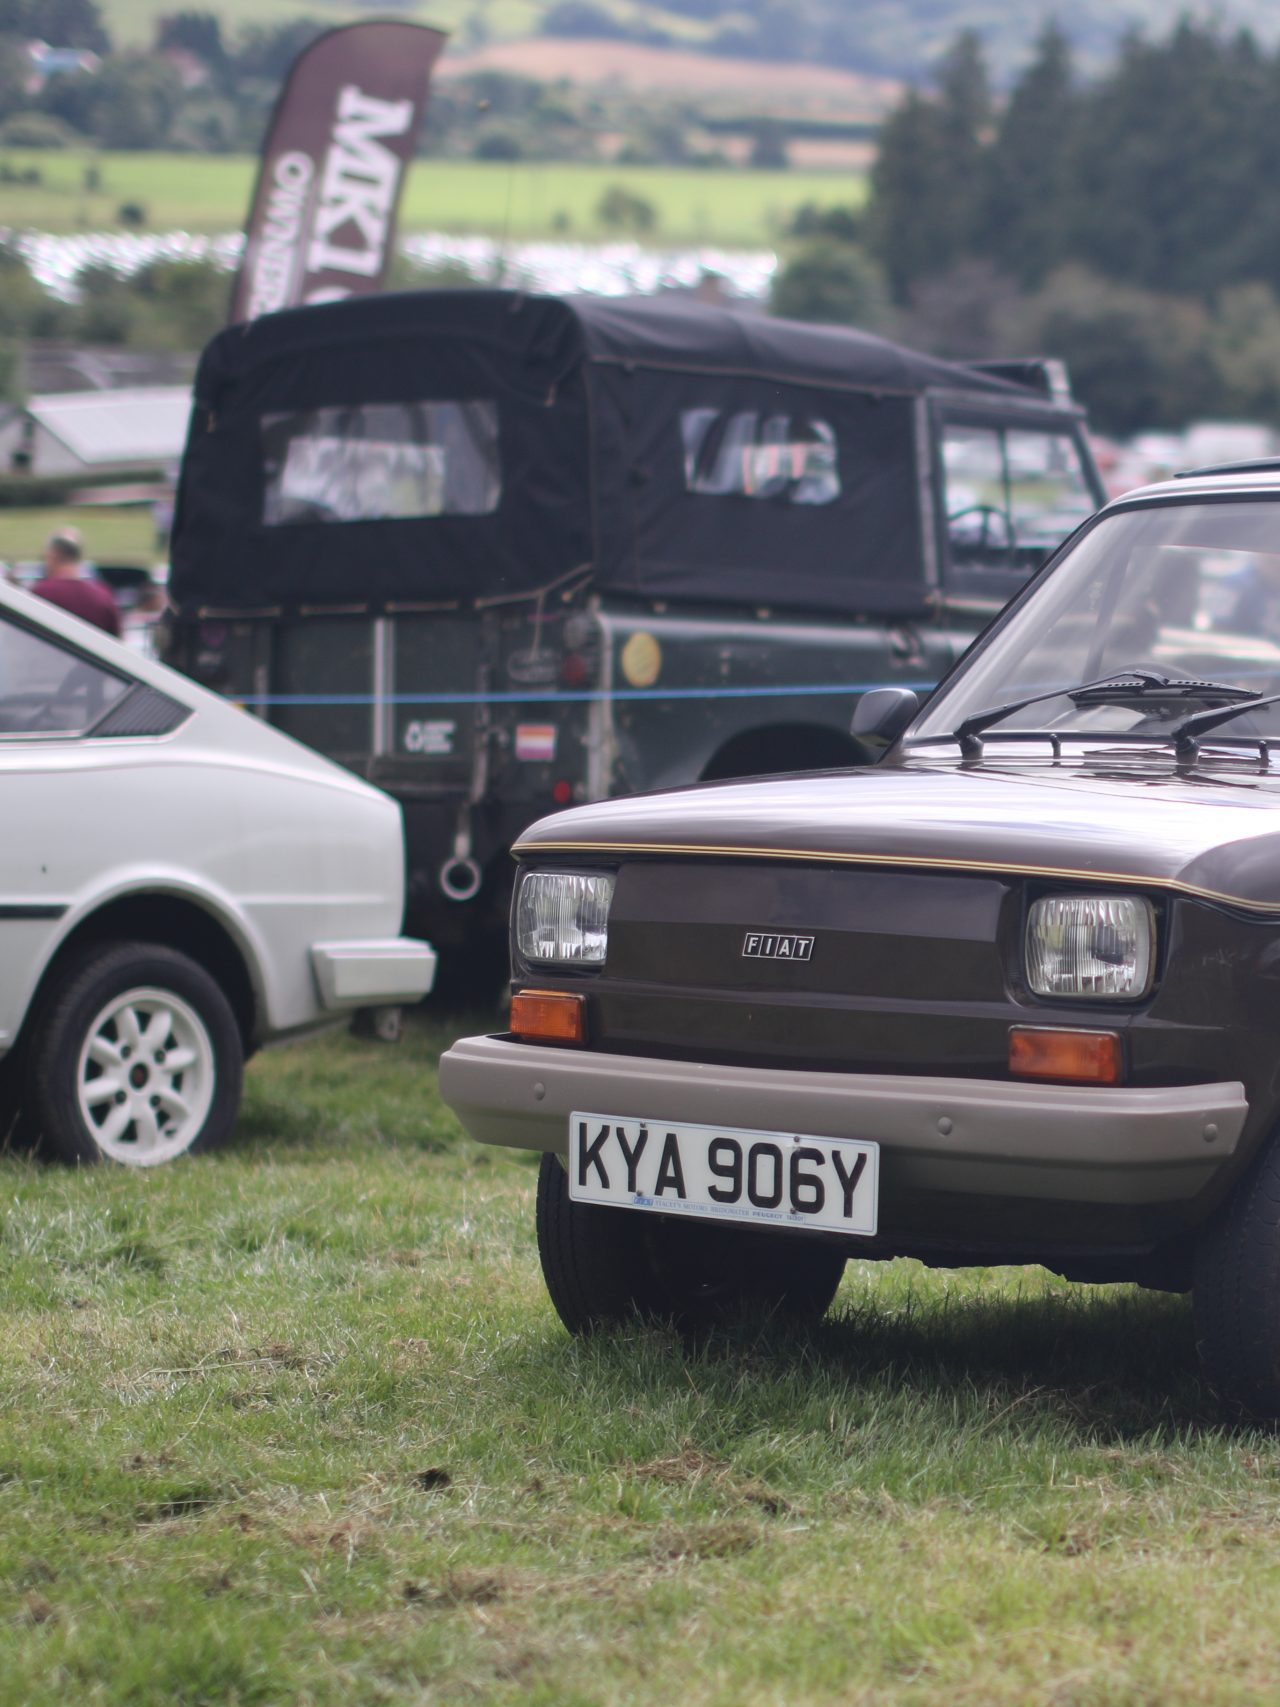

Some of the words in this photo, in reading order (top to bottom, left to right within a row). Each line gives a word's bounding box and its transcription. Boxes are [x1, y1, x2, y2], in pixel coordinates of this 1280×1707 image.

[746, 936, 811, 957] FIAT
[578, 1122, 687, 1199] KYA
[707, 1137, 867, 1218] 906Y
